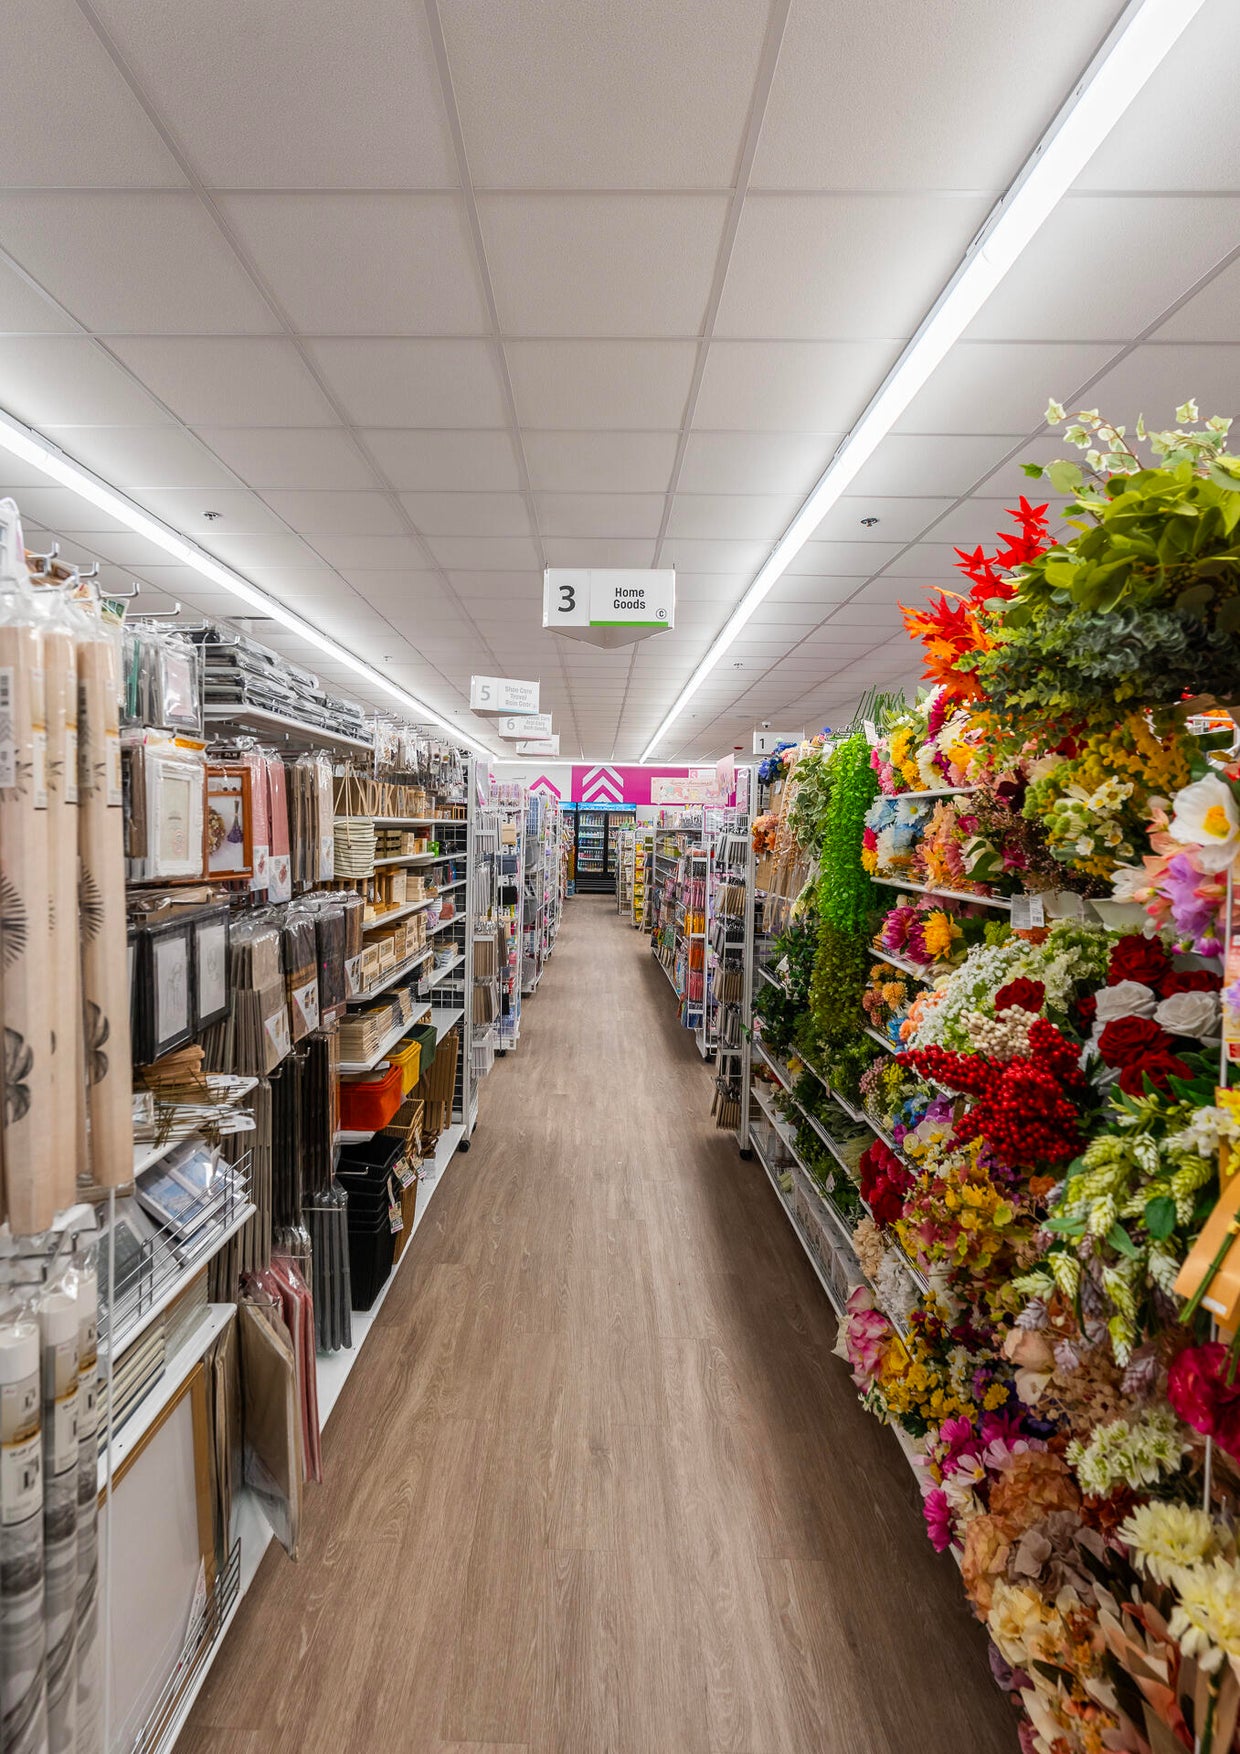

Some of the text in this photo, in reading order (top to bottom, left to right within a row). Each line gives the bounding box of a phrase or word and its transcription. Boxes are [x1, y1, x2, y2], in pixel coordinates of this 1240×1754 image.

[615, 587, 645, 598] Home
[557, 585, 576, 613] 3
[613, 599, 646, 609] Goods
[480, 685, 490, 701] 5
[506, 718, 515, 730] 6
[760, 738, 764, 749] 1
